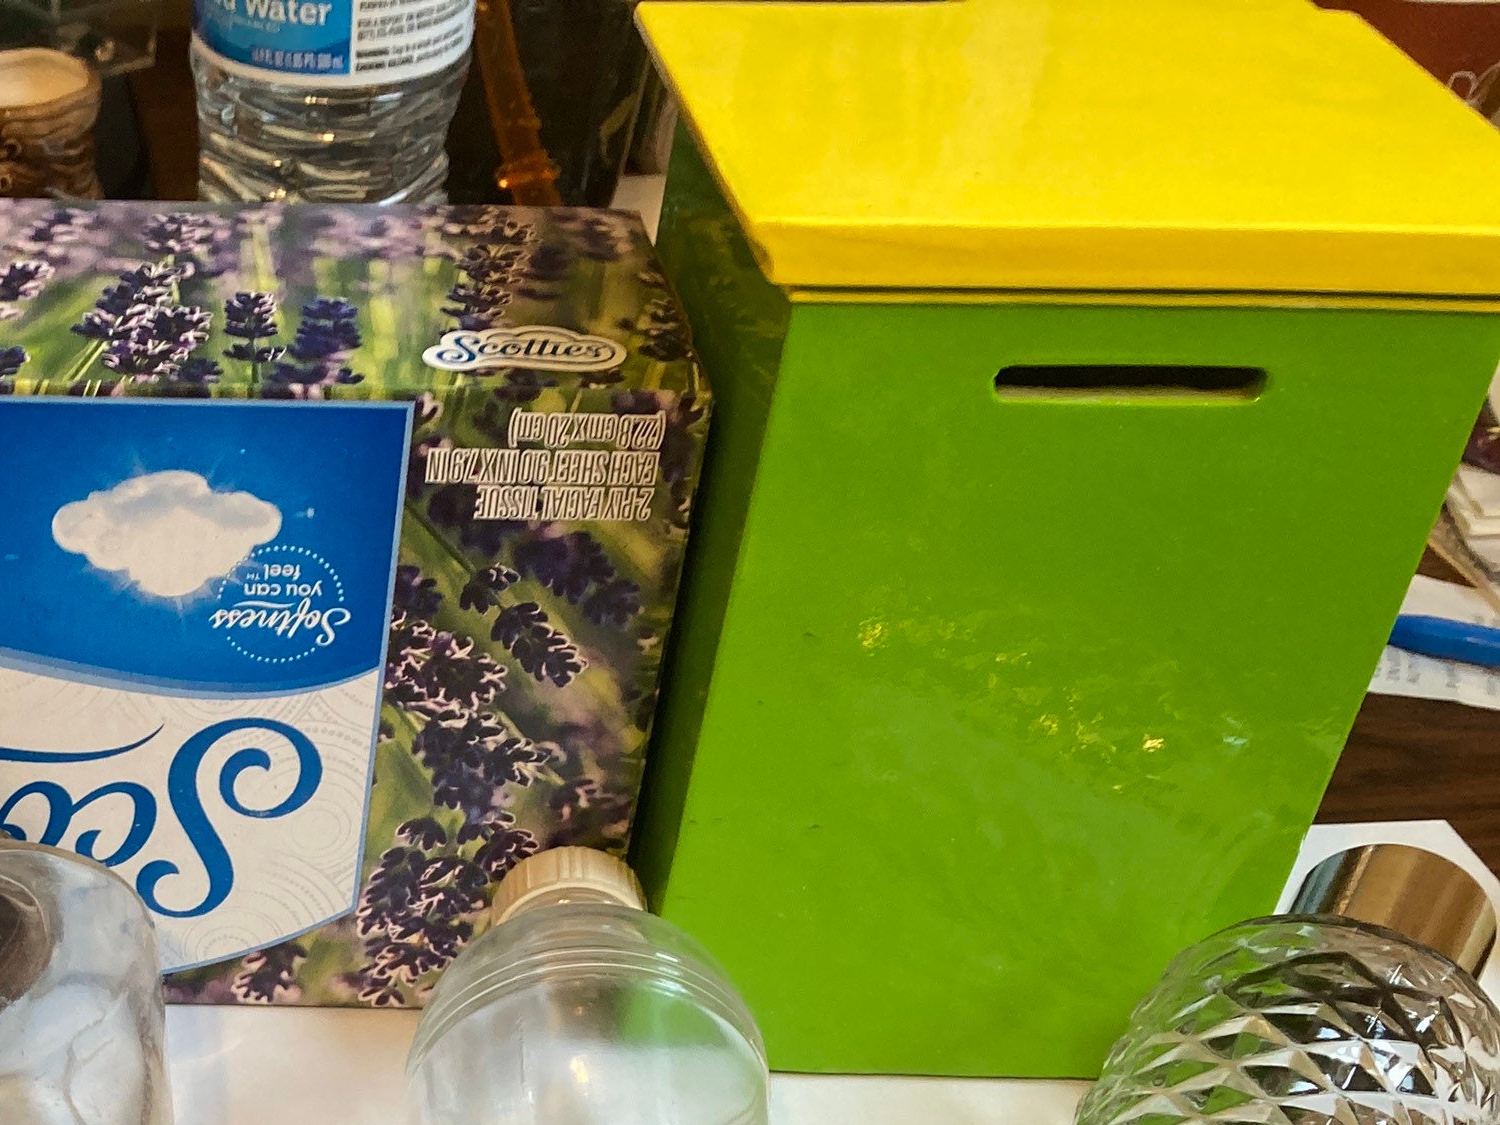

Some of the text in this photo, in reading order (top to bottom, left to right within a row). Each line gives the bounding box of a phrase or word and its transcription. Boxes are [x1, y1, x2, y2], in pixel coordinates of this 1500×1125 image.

[437, 333, 603, 364] Scotties
[549, 450, 609, 485] SHEET
[607, 451, 660, 485] EACH
[474, 485, 655, 521] 2-PLY FACIAL TISSUE
[244, 579, 323, 597] you can
[208, 597, 351, 646] Softness
